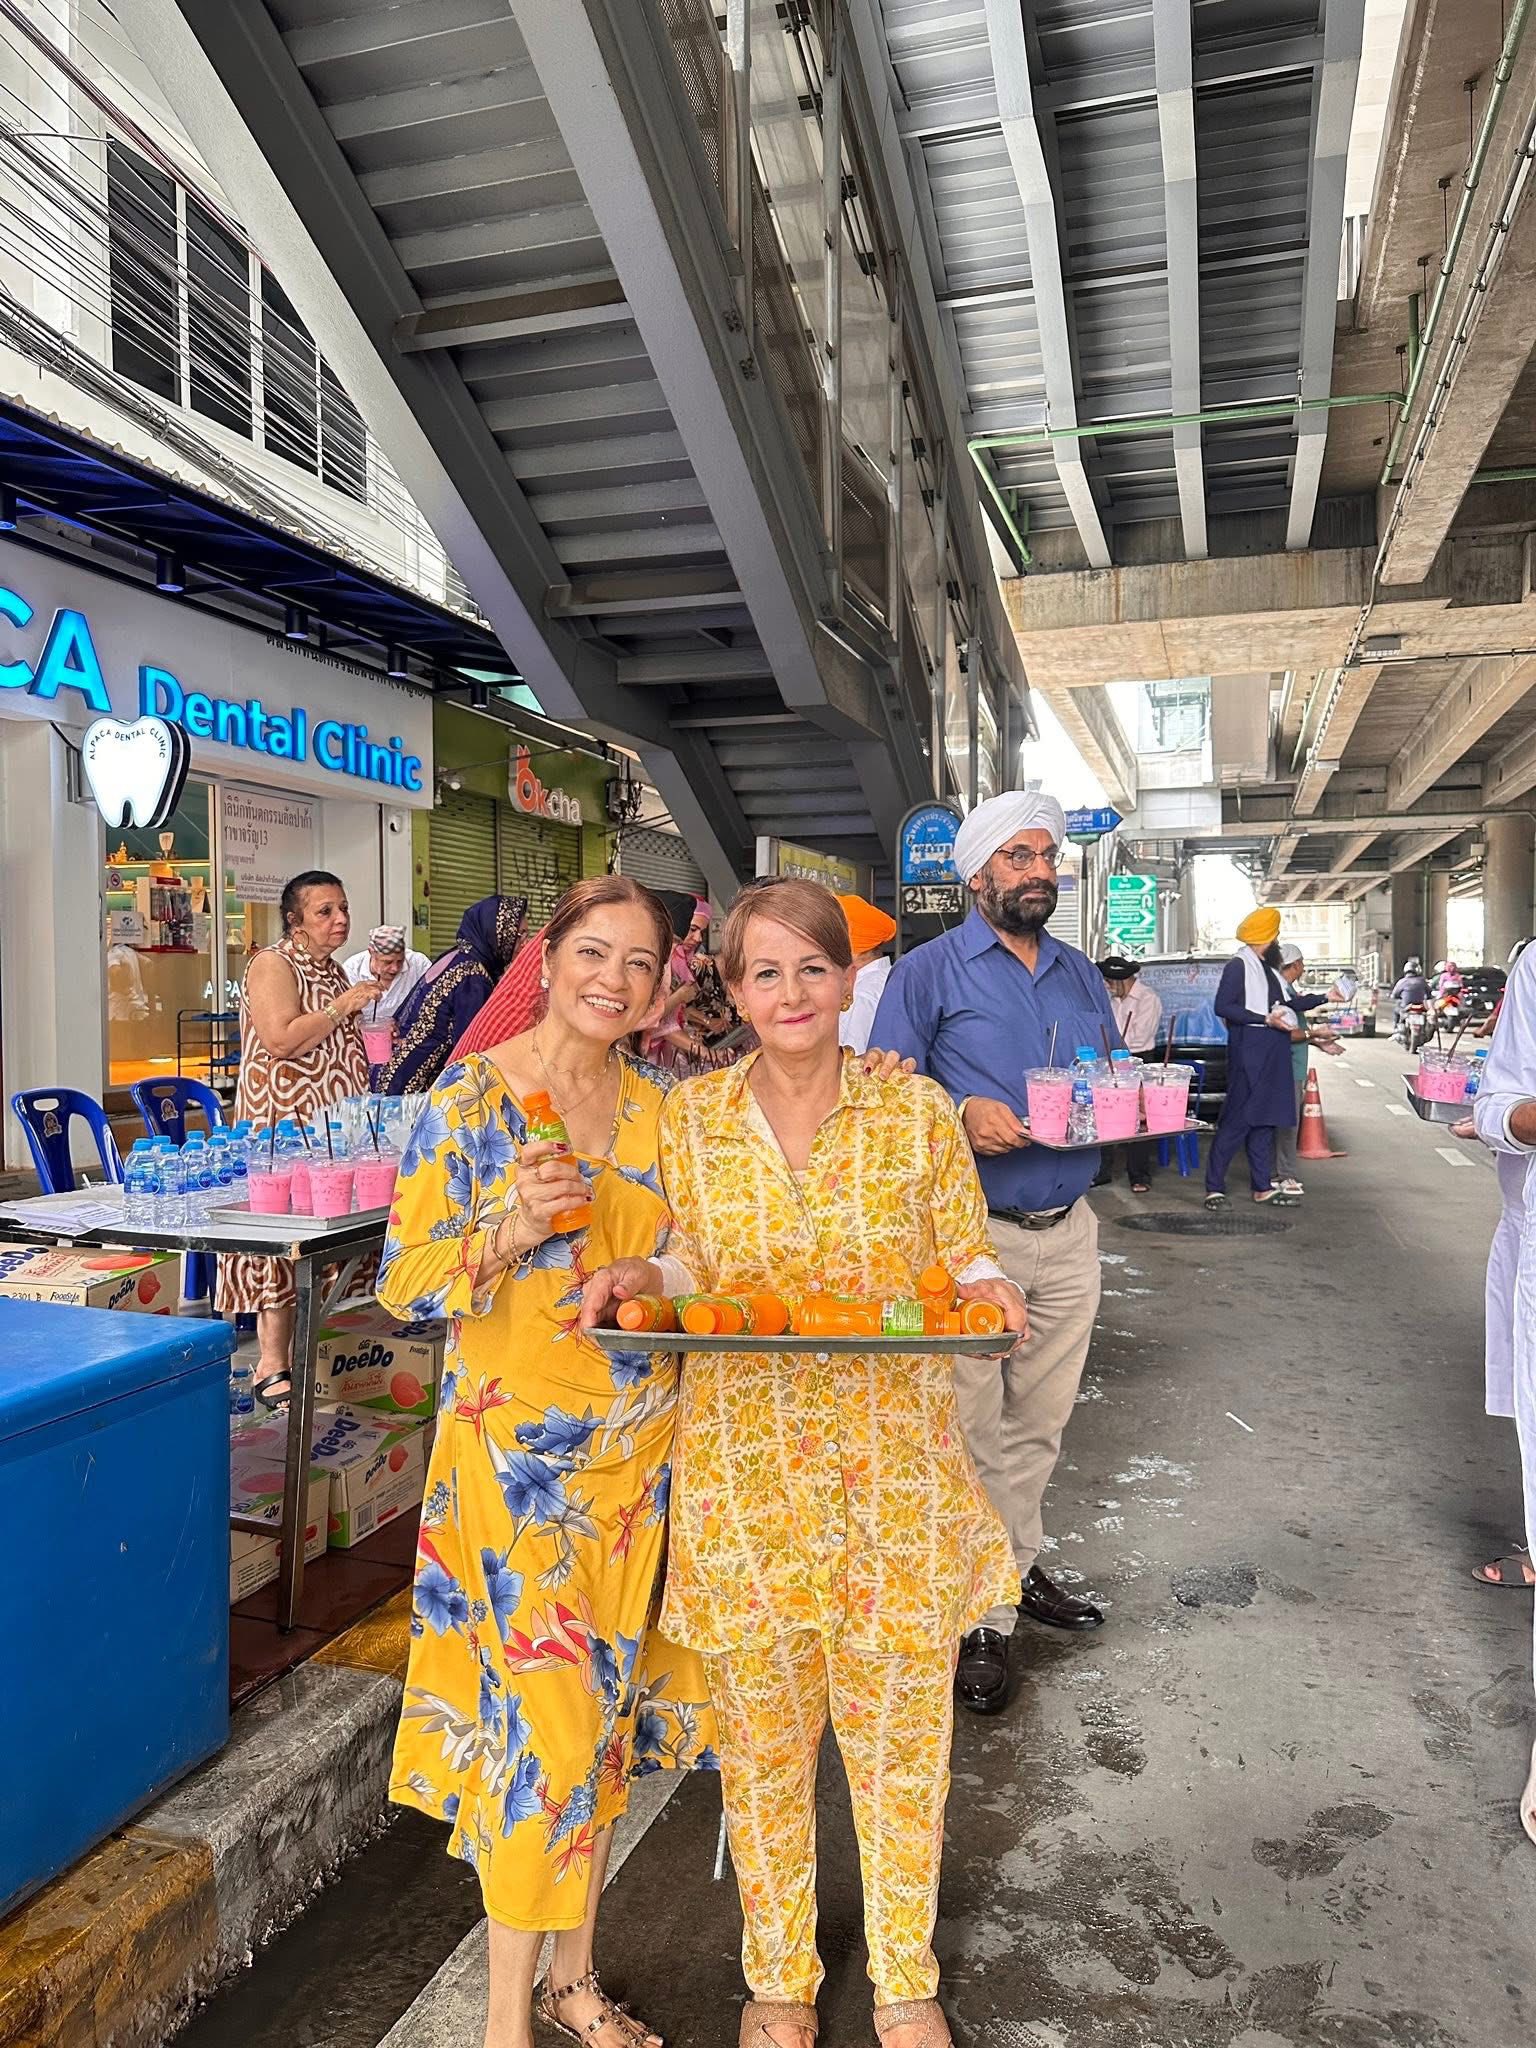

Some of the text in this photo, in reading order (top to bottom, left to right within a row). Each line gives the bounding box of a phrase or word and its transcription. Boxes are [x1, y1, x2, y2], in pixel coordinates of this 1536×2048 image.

[89, 728, 167, 760] ALPACA DENTAL CLINIC
[138, 665, 306, 762] Dental
[312, 720, 423, 792] Clinic
[1100, 812, 1111, 825] 11
[0, 1246, 49, 1280] eeDo
[331, 1343, 394, 1376] DeeDo
